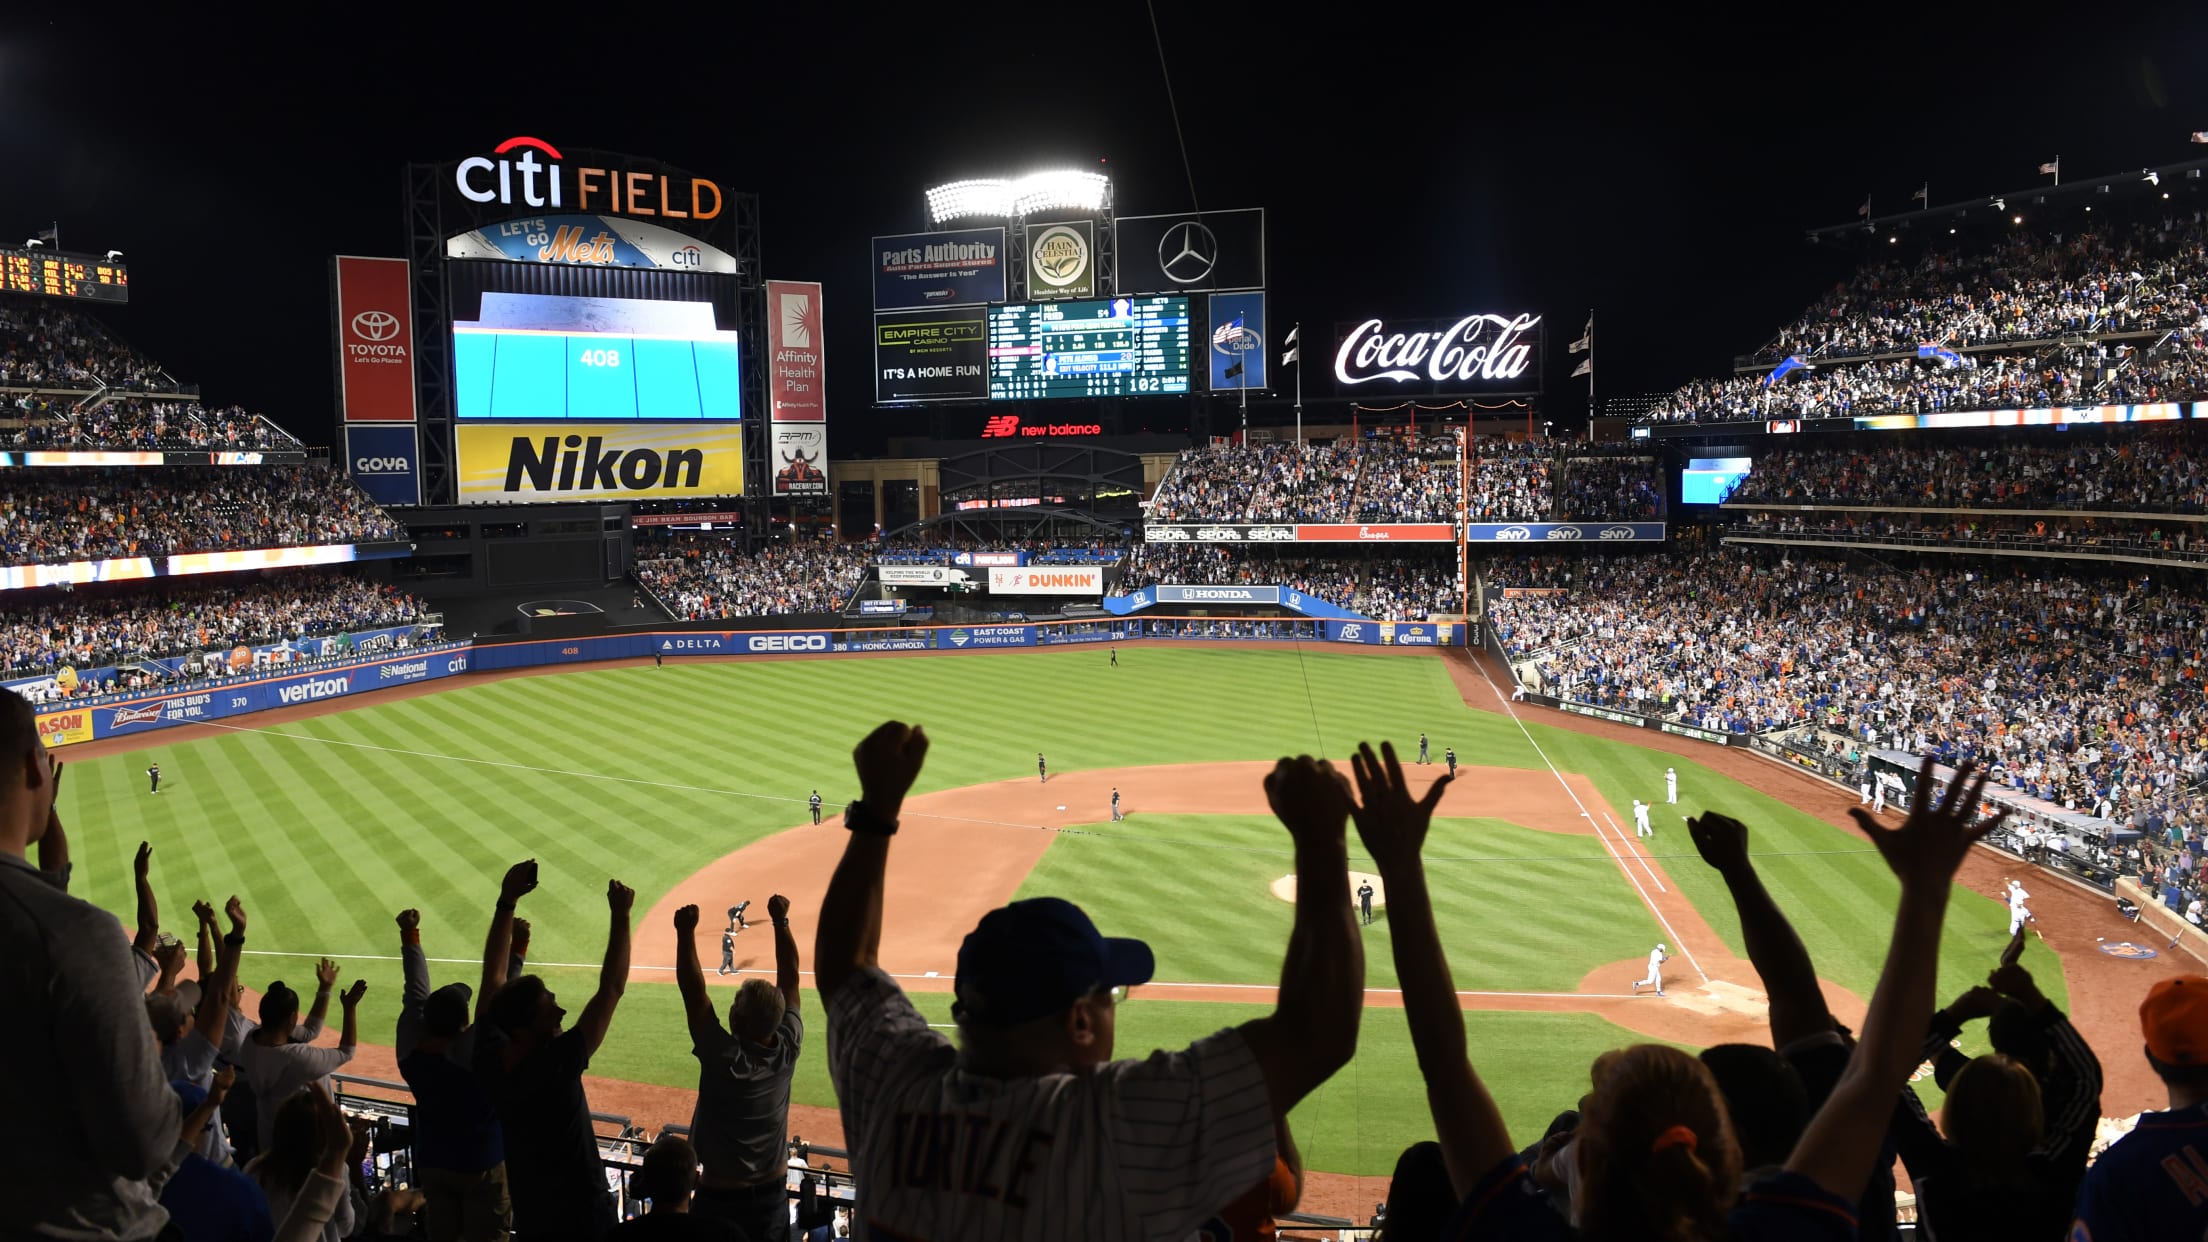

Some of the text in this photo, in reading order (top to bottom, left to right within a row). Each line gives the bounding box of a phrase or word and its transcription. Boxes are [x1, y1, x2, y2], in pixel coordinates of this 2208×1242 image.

[456, 150, 722, 220] citi FIELD
[500, 219, 546, 237] LET'S
[527, 233, 549, 246] GO
[539, 225, 615, 263] Mets
[1048, 242, 1073, 250] HAIN
[672, 250, 701, 266] citi
[882, 241, 995, 265] Parts Authority
[1097, 309, 1109, 318] 54
[884, 326, 977, 339] EMPIRE CITY
[913, 337, 948, 345] CASINO
[348, 344, 406, 357] TOYOTA
[1335, 313, 1541, 384] Coca-Cola
[580, 349, 620, 368] 408
[776, 351, 817, 366] Affinity
[779, 366, 815, 379] Health
[883, 368, 905, 380] IT'S
[907, 367, 916, 379] A
[918, 366, 953, 378] HOME
[955, 365, 981, 376] RUN
[786, 380, 809, 392] Plan
[1130, 377, 1159, 391] 102
[1021, 426, 1046, 436] new
[1049, 423, 1101, 436] balance
[356, 457, 408, 473] GOYA
[503, 434, 704, 492] Nikon
[1496, 529, 1631, 540] SNY SNY SNY
[1029, 574, 1096, 587] DUNKIN'
[1195, 590, 1252, 599] HONDA
[973, 627, 1025, 636] EAST COAST
[1111, 632, 1125, 640] 370
[1340, 623, 1362, 639] RTS
[676, 639, 721, 649] DELTA
[749, 635, 826, 651] GEICO
[974, 636, 1002, 644] POWER
[1399, 633, 1432, 644] Corona
[561, 647, 579, 655] 408
[833, 643, 848, 652] 380
[862, 641, 925, 650] KONICA MINOLTA
[391, 660, 427, 676] National
[448, 657, 467, 672] citi
[279, 676, 348, 703] verizon
[167, 694, 210, 710] THIS BUD'S
[231, 697, 247, 708] 370
[116, 709, 161, 723] Budweiser
[167, 707, 203, 720] FOR YOU.
